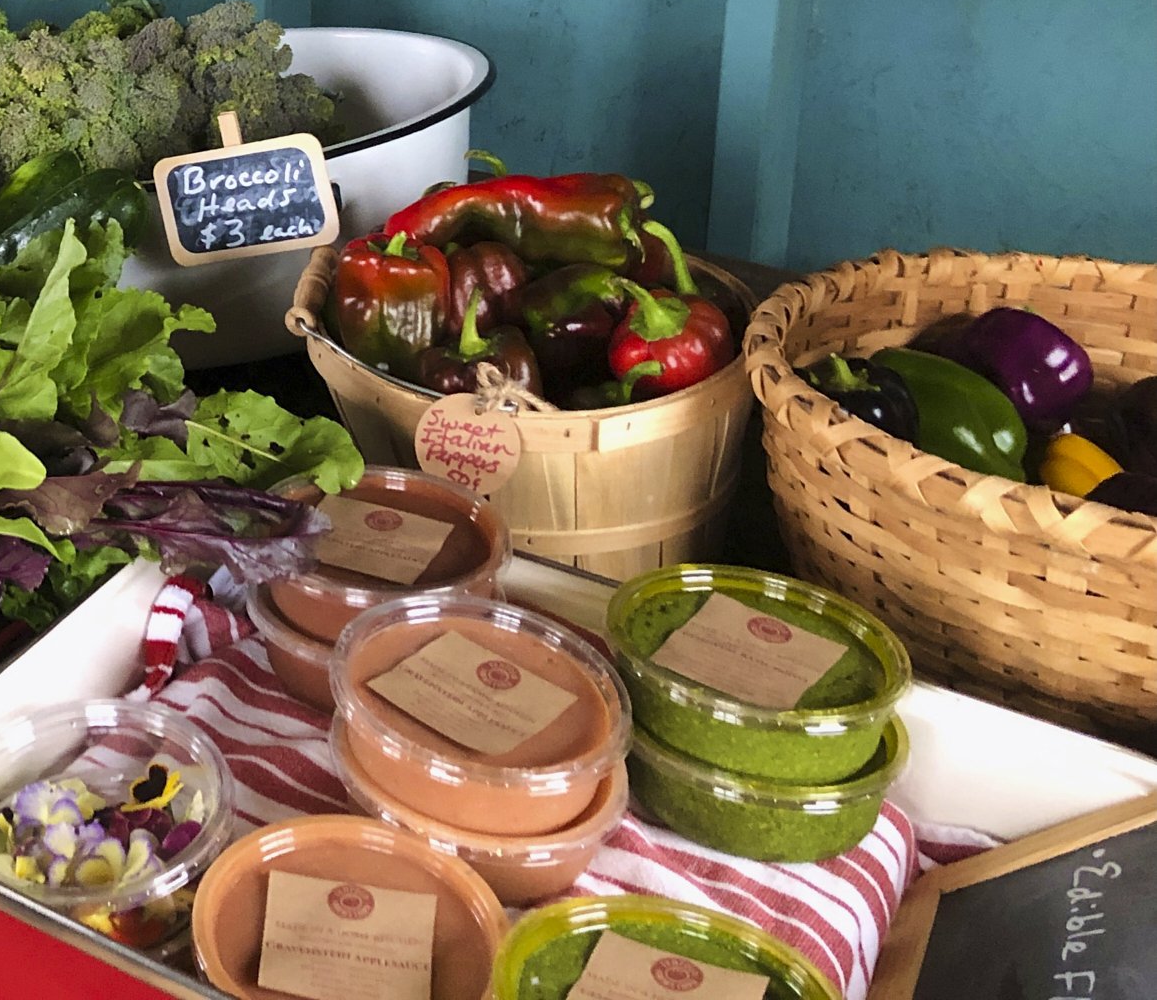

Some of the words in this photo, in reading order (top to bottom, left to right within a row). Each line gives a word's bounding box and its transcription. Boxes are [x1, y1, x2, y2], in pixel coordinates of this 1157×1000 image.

[183, 158, 305, 196] Broccoli
[259, 218, 315, 241] each
[427, 408, 505, 438] Sweet
[420, 424, 515, 457] Italian
[1061, 861, 1123, 962] Edible
